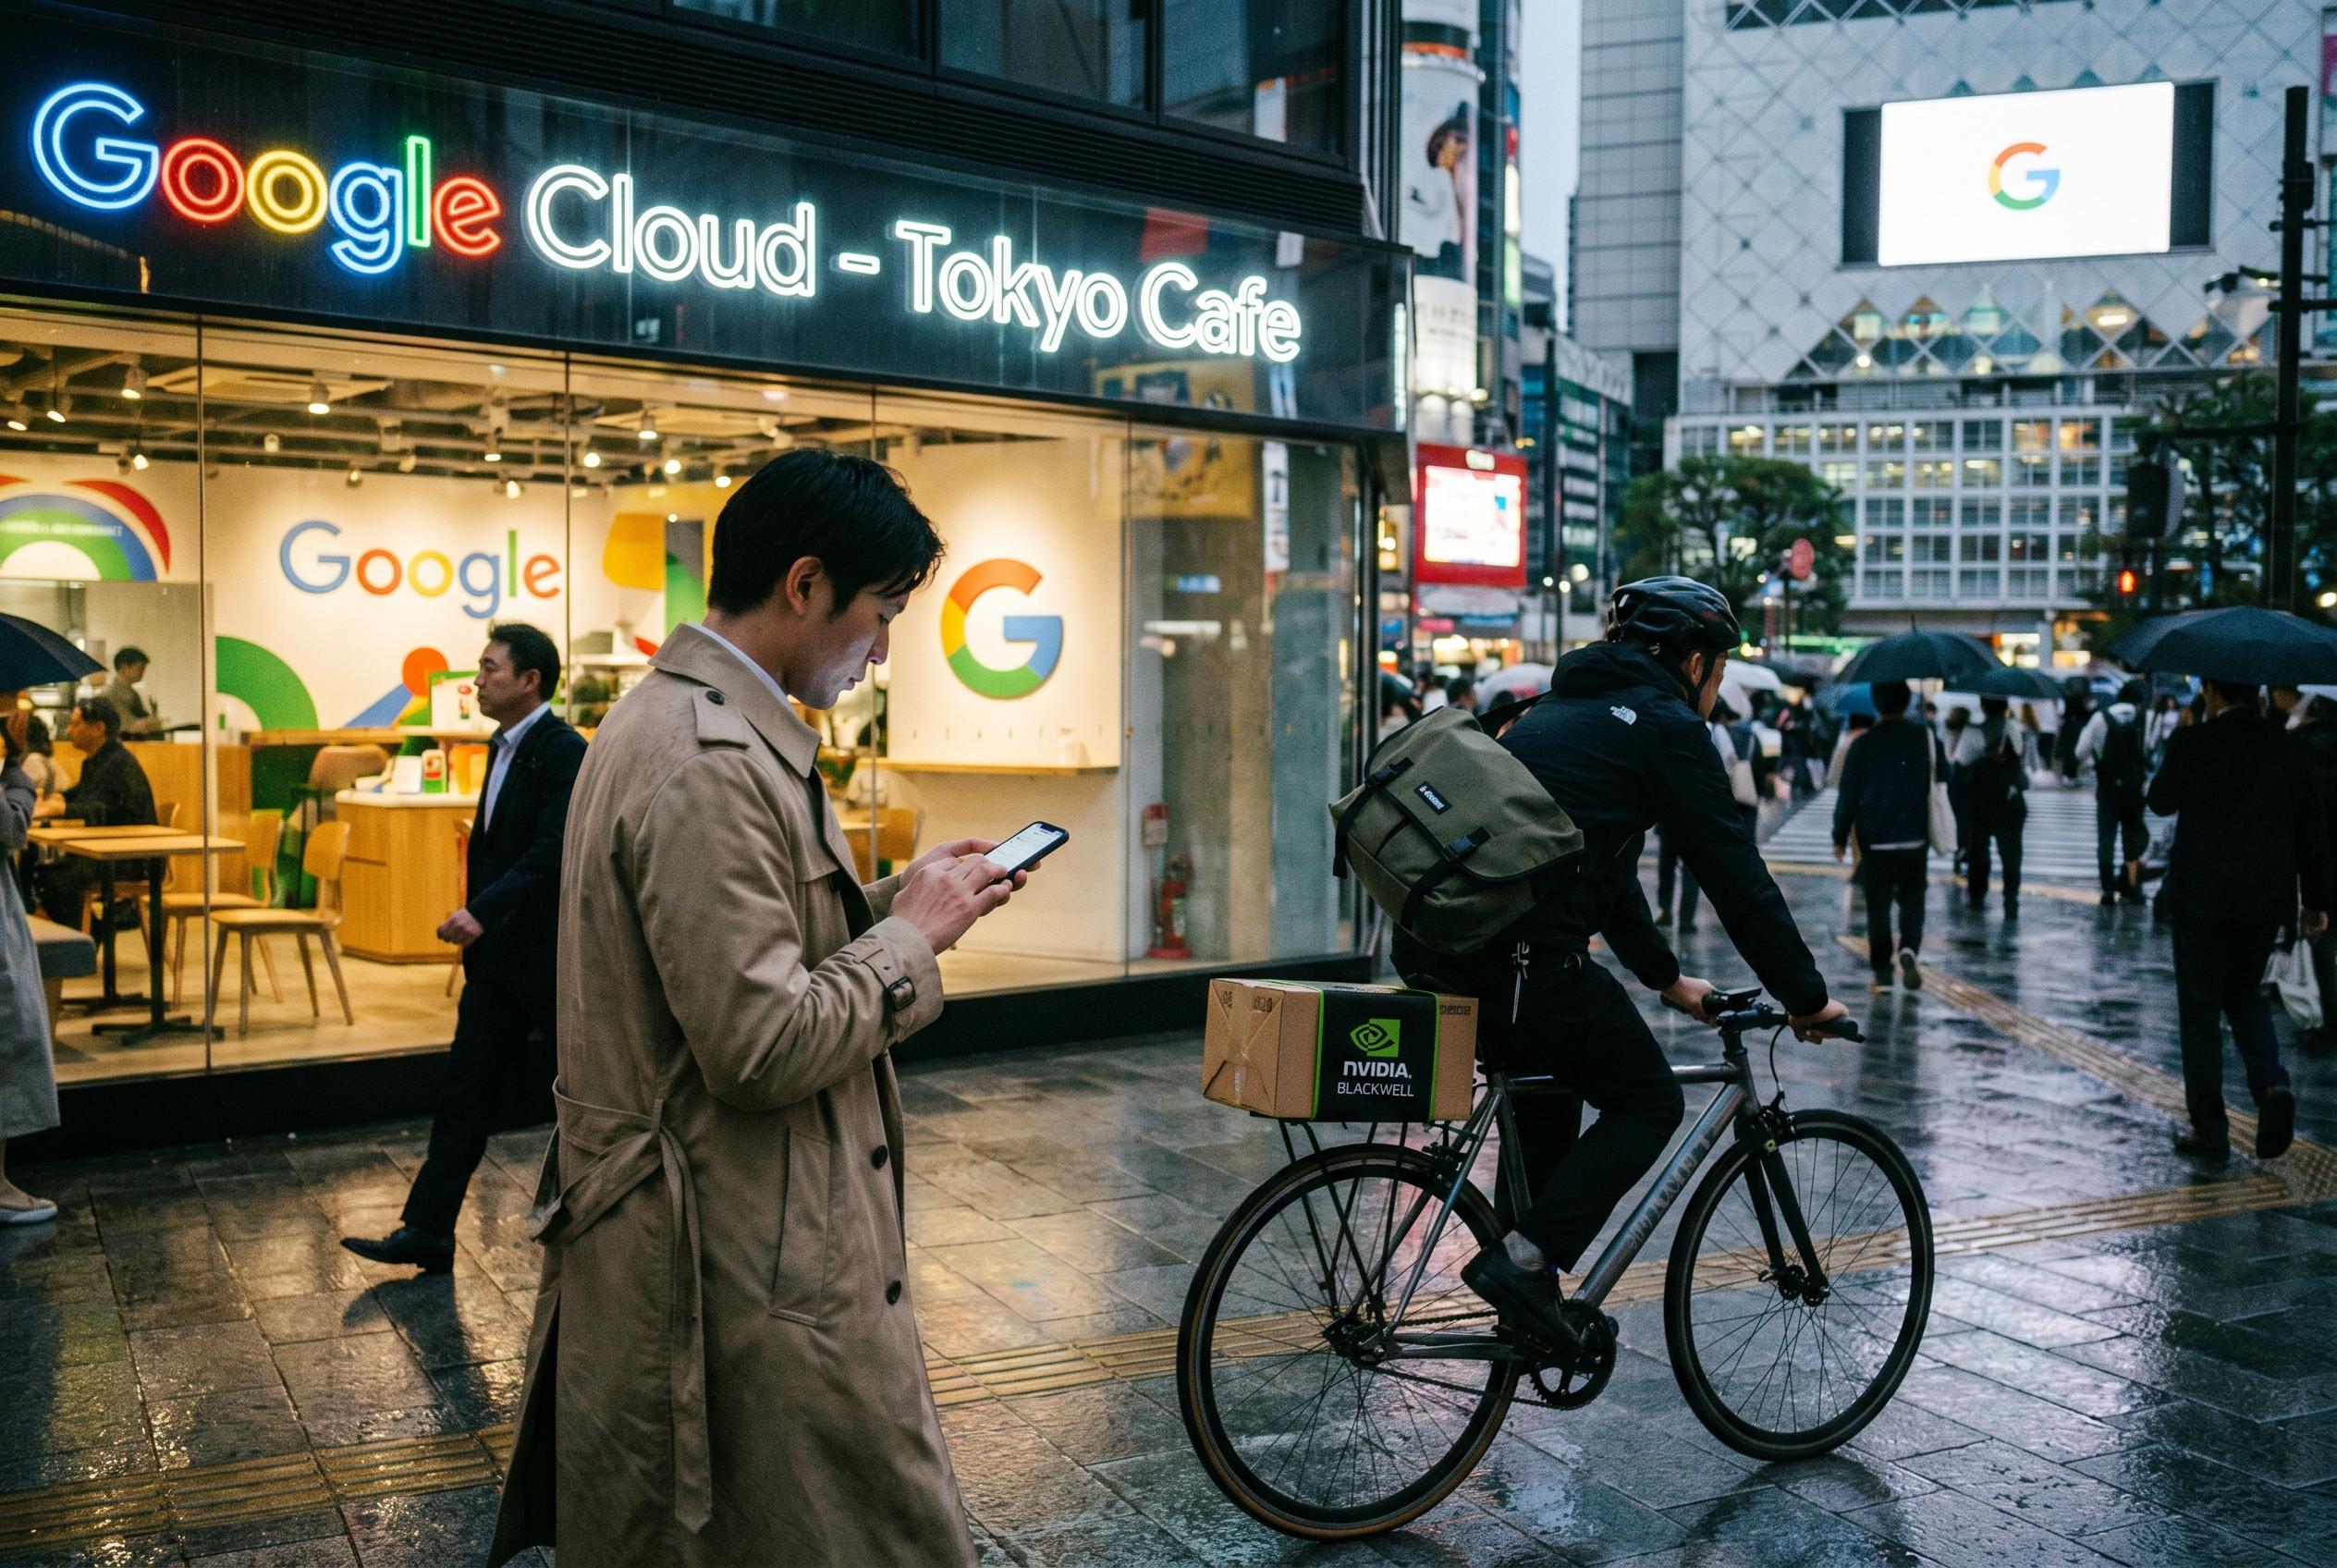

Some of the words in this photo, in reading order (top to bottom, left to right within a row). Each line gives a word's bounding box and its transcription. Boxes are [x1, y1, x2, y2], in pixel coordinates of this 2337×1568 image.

[31, 82, 503, 275] Google
[527, 165, 815, 298] Cloud
[895, 219, 1128, 352] Tokyo
[1140, 262, 1302, 362] Cafe
[279, 520, 561, 619] Google
[1337, 1082, 1414, 1097] BLACKWELL
